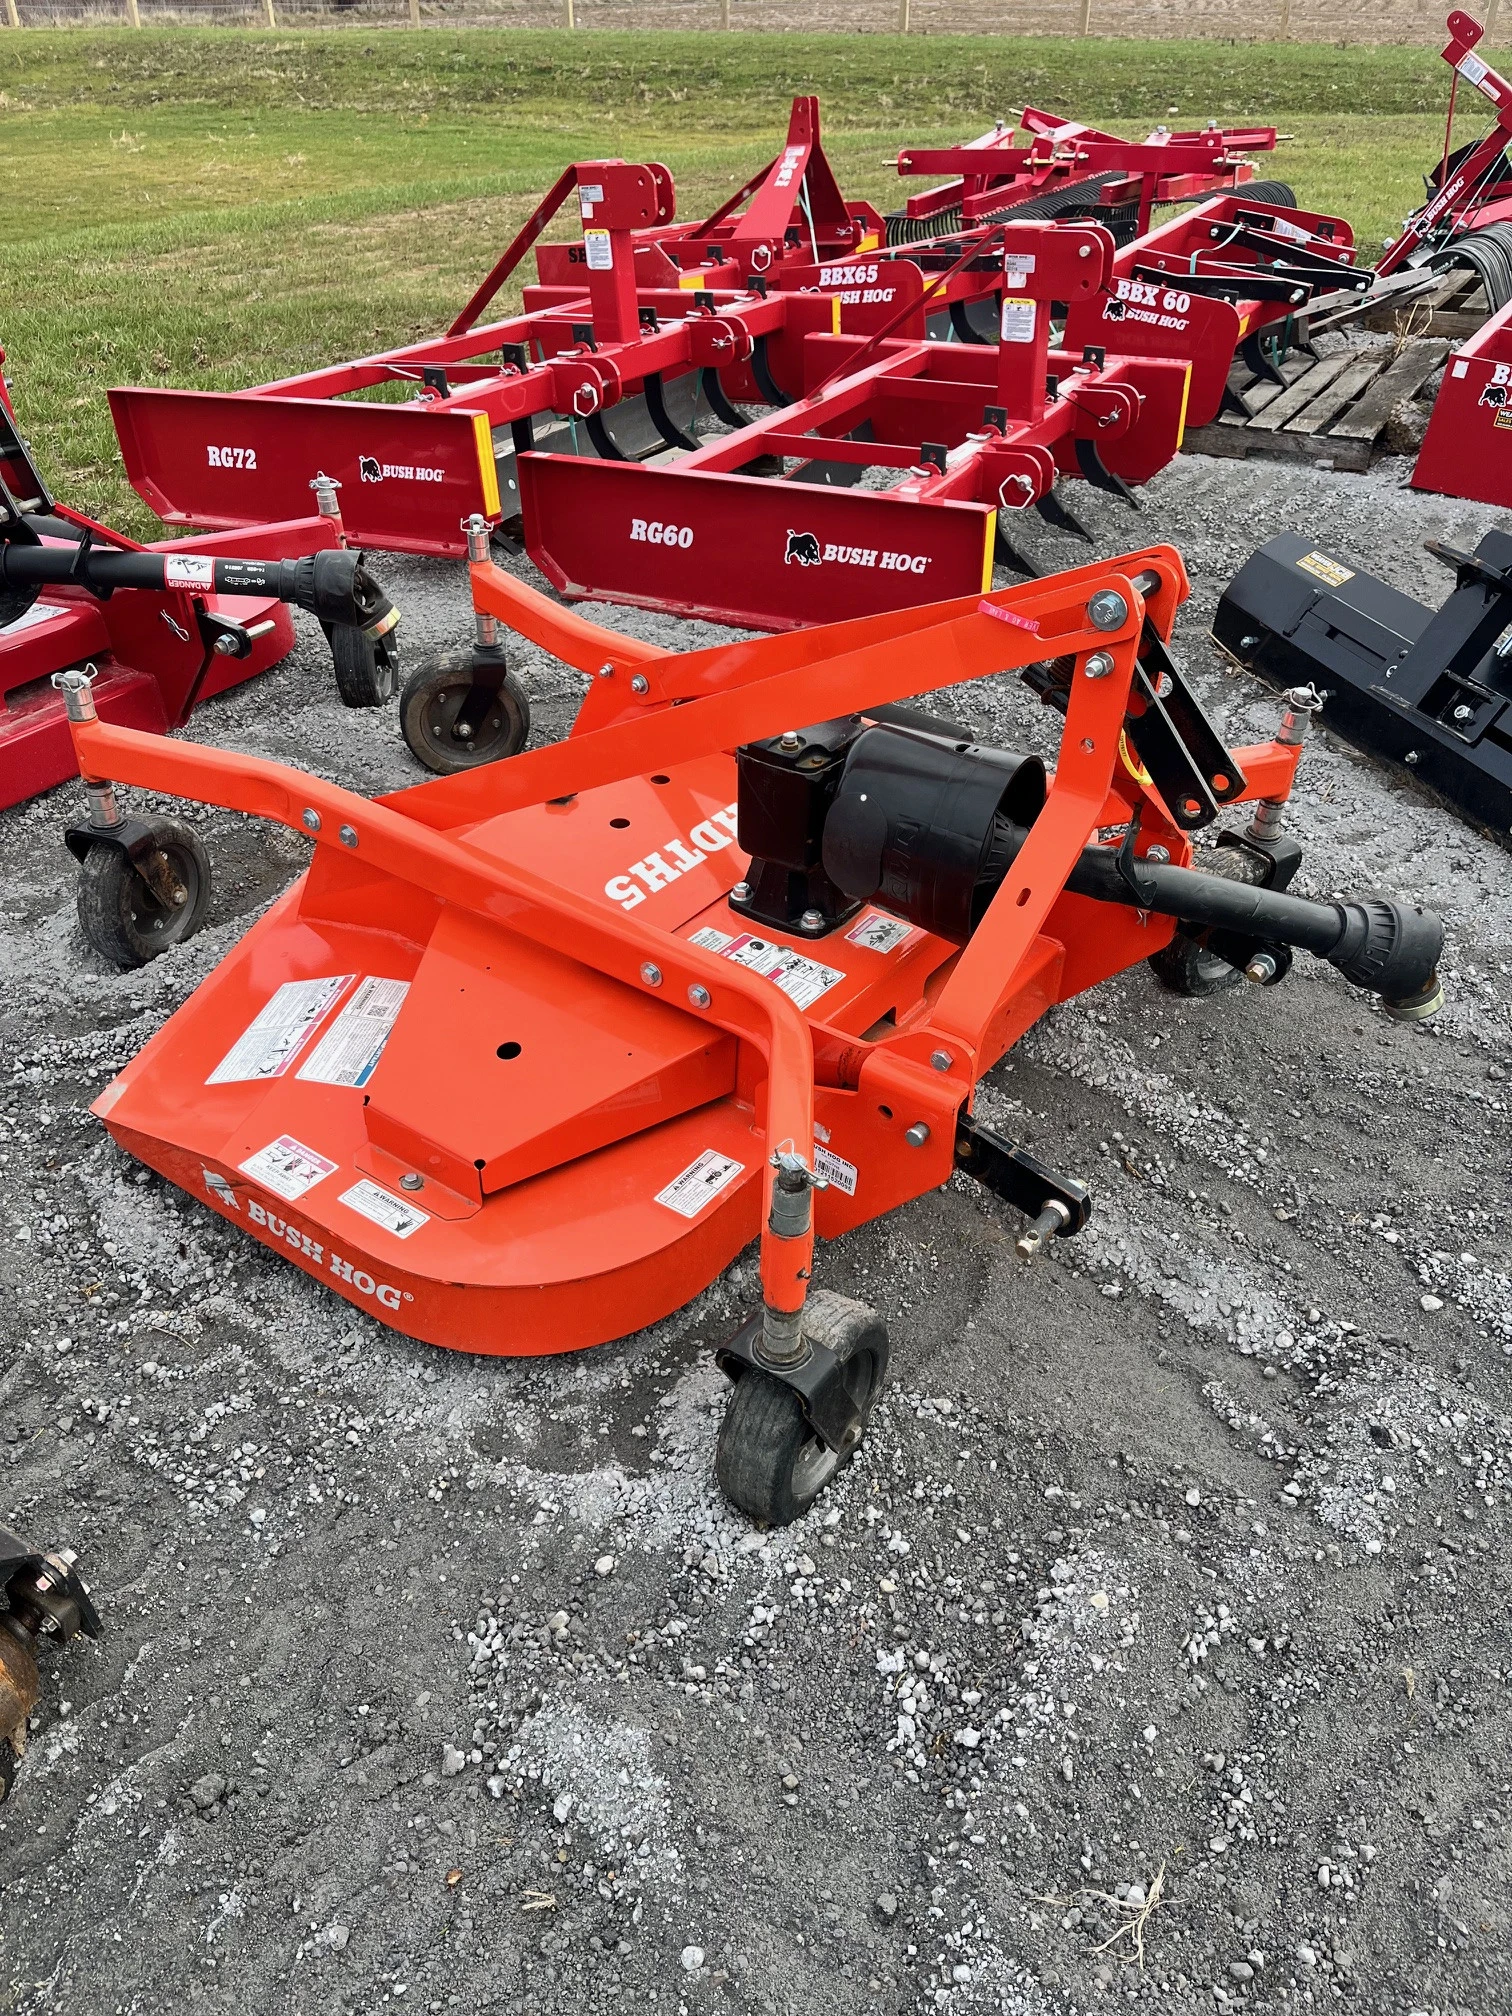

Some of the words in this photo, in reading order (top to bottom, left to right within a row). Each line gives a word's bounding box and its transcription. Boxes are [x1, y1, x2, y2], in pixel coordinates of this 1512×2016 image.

[1426, 195, 1449, 222] BUSH
[1445, 175, 1465, 200] HOG
[819, 264, 878, 286] BBX65
[862, 288, 896, 303] HOG
[1115, 279, 1160, 307] BBX
[1162, 290, 1191, 313] 60
[1158, 314, 1189, 331] HOG
[206, 445, 257, 470] RG72
[382, 464, 414, 480] BUSH
[415, 468, 445, 482] HOG
[630, 518, 694, 549] RG60
[822, 543, 877, 568] BUSH
[879, 551, 932, 574] HOG
[168, 579, 200, 589] DANGER
[604, 802, 738, 911] HDTH5
[678, 1162, 704, 1186] WARNING
[379, 1194, 410, 1214] WARNING
[248, 1199, 324, 1265] BUSH
